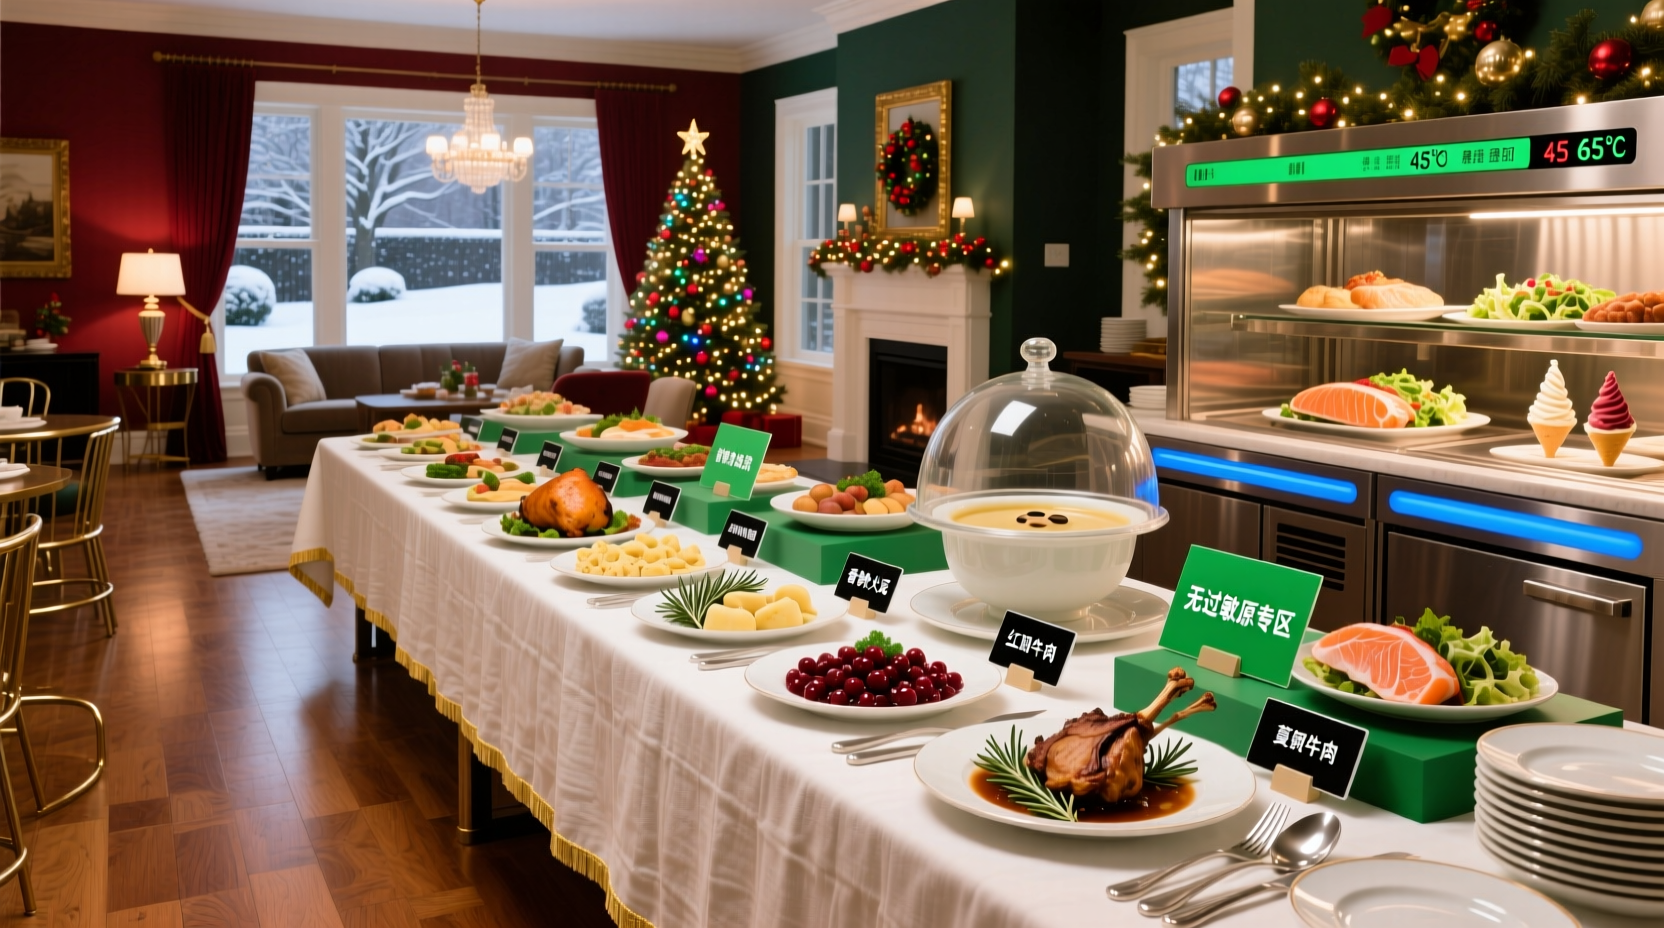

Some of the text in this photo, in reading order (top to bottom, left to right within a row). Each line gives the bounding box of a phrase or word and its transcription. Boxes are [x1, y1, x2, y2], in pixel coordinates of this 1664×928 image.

[1543, 140, 1569, 163] 45
[1576, 135, 1627, 161] 65°C
[1183, 584, 1297, 639] 无过敏原专区
